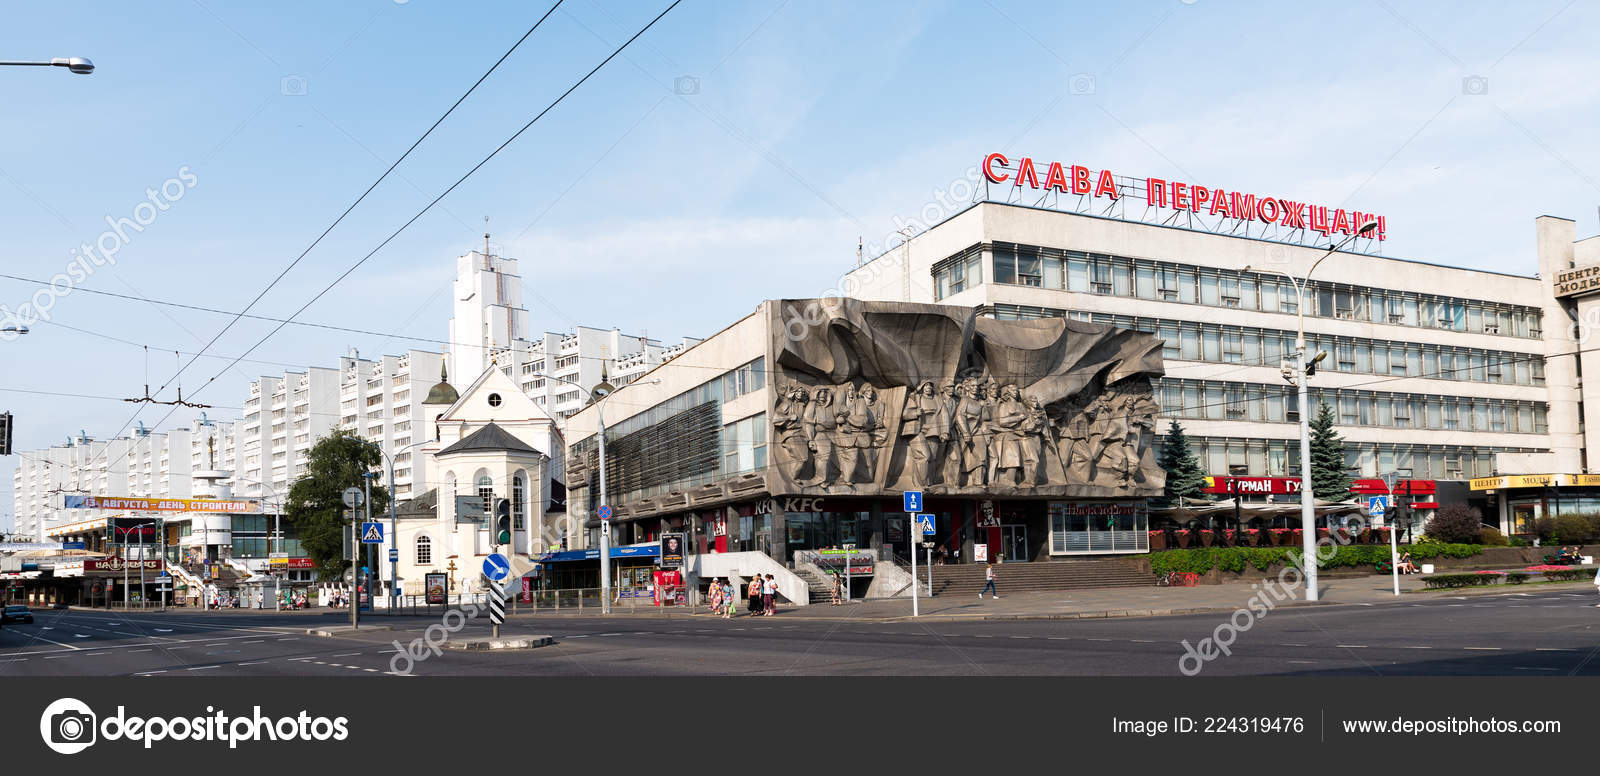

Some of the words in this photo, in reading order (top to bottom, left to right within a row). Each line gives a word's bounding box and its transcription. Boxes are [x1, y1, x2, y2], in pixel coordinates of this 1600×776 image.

[982, 152, 1119, 200] СЛАВА
[1146, 177, 1387, 241] ПЕРАМОЖЦАМ!
[1558, 266, 1600, 283] ЦЕНТР
[1475, 479, 1503, 488] ЦЕНТР
[102, 499, 148, 509] АВГУСТА
[158, 500, 185, 510] ДЕНЬ
[190, 501, 246, 511] СТРОИТЕЛЯ
[784, 497, 824, 512] KFC
